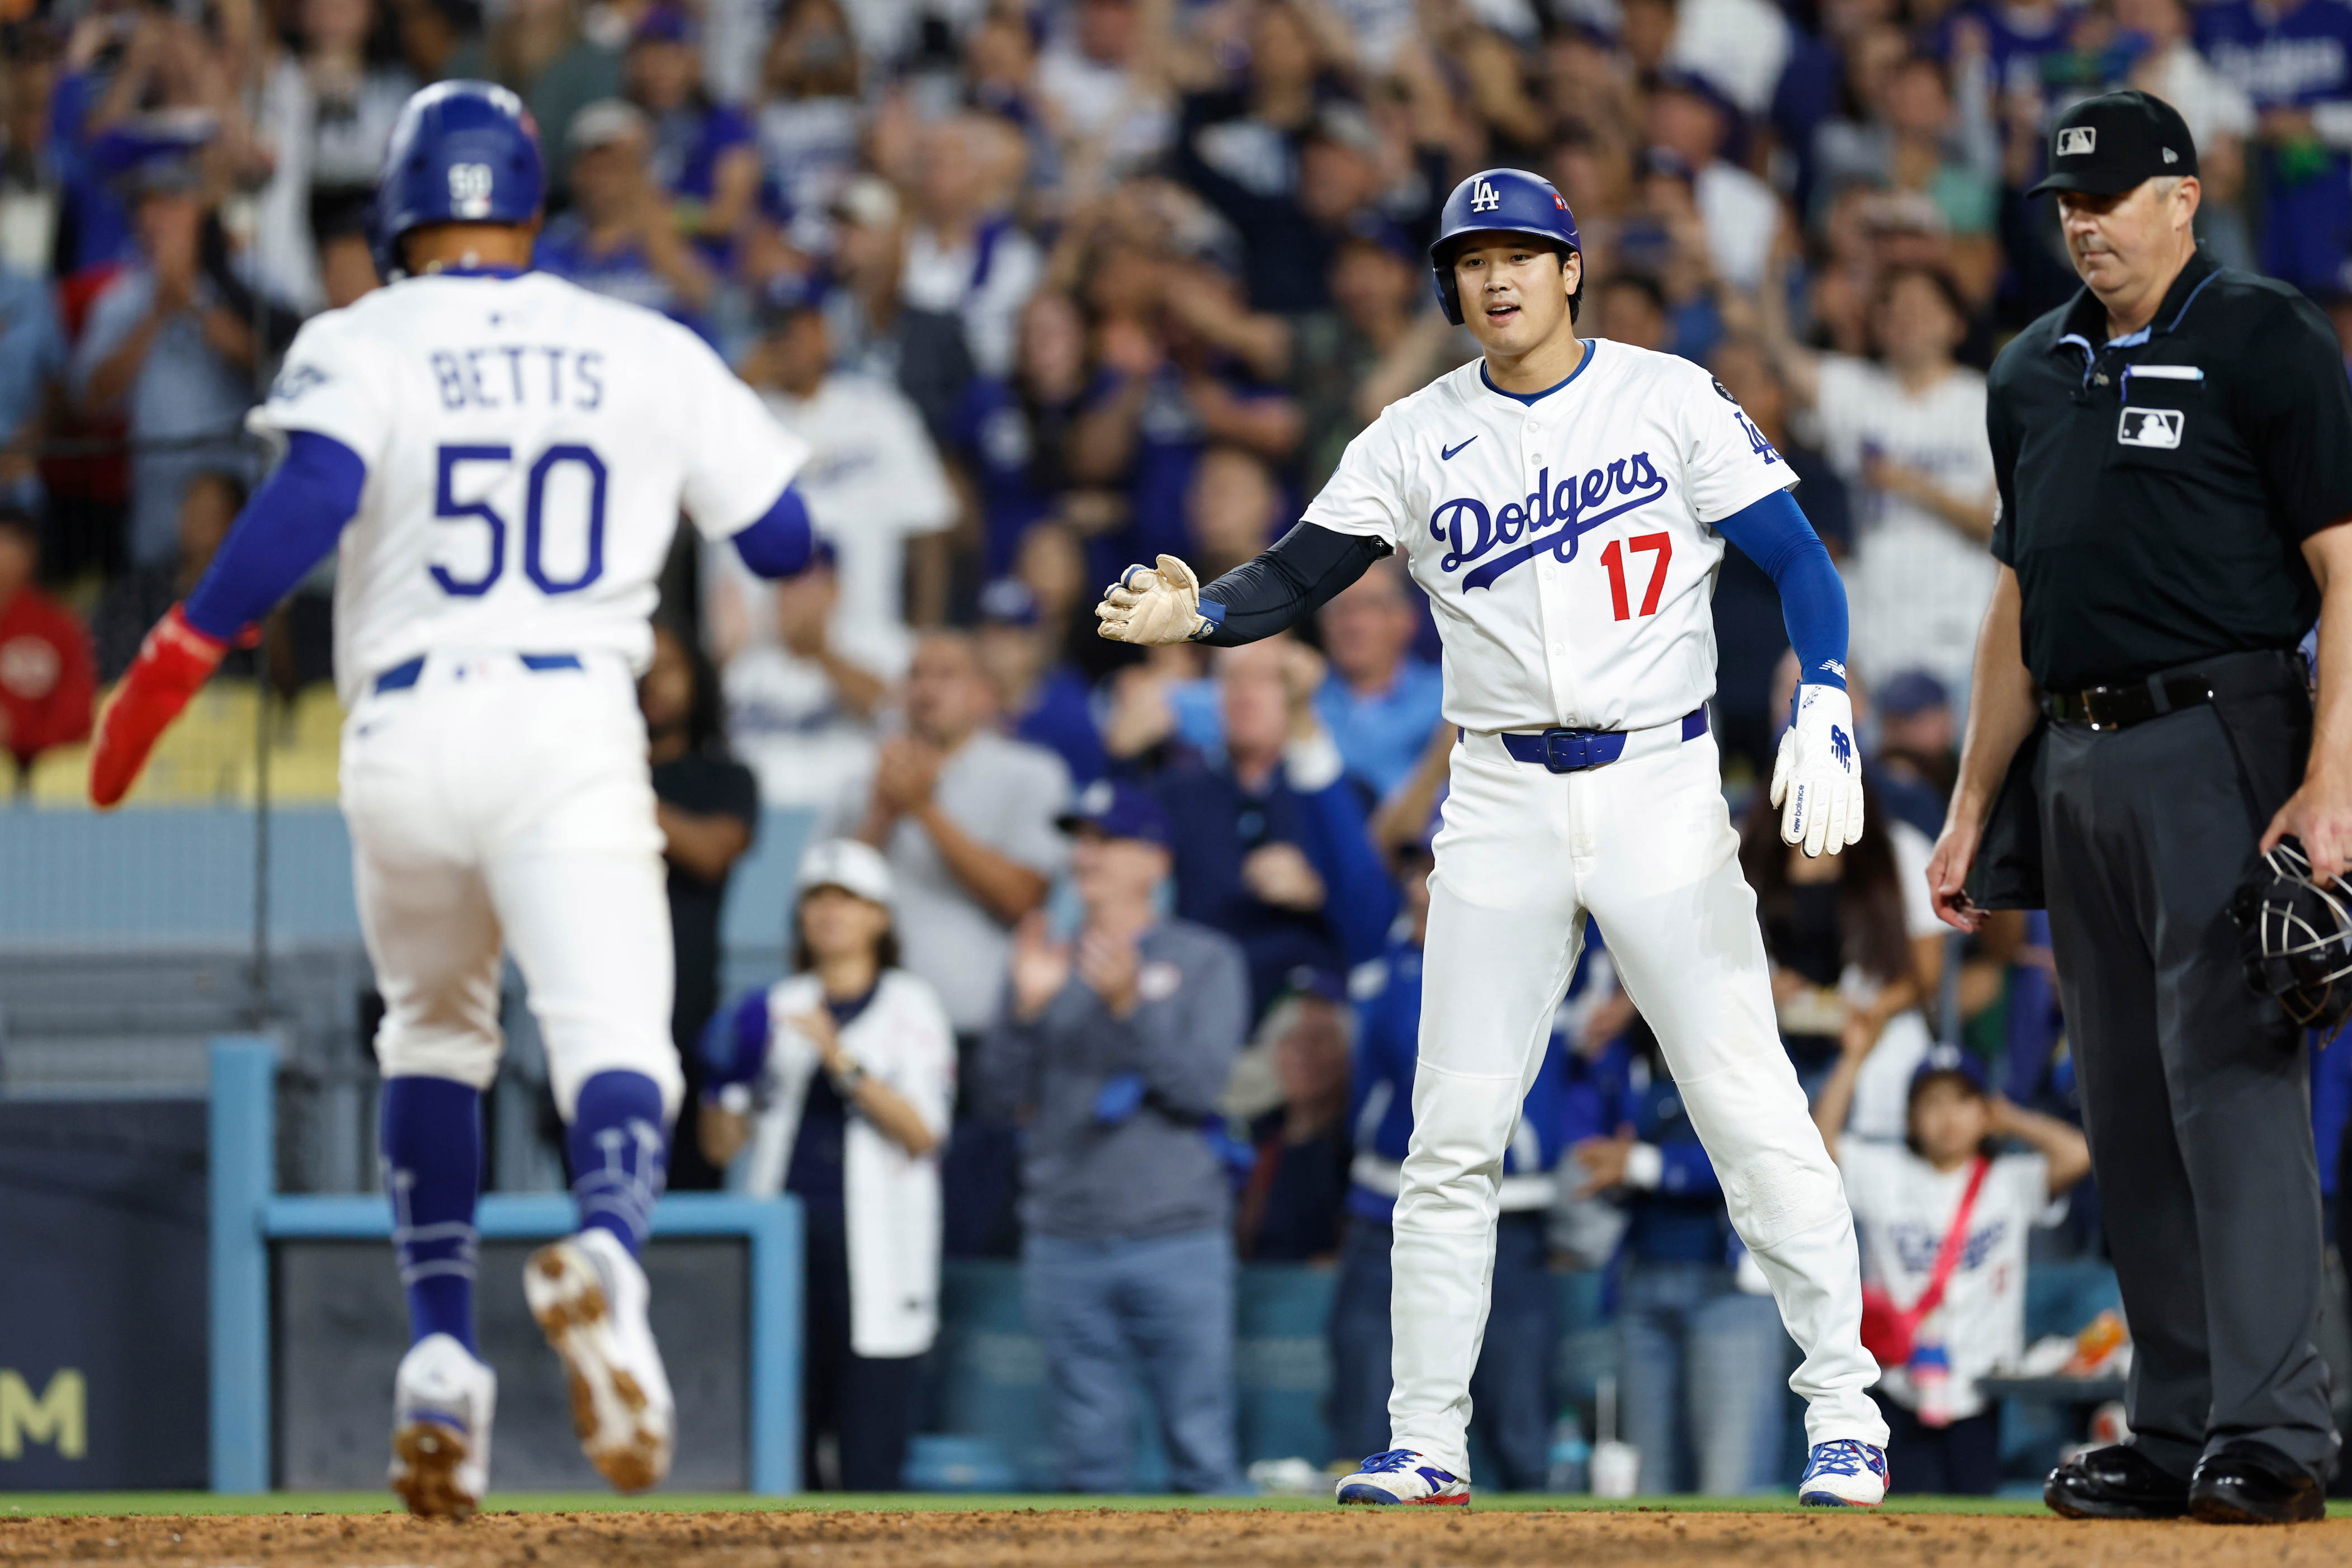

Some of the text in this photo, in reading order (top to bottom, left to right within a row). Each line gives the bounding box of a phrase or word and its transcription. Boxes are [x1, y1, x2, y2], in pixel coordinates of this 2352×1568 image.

[1470, 176, 1500, 213] LA
[431, 344, 606, 411] BETTS
[428, 445, 607, 597] 50
[1429, 451, 1668, 573] Dodgers
[1599, 531, 1673, 621] 17
[1794, 784, 1805, 816] balance
[0, 1367, 87, 1458] M
